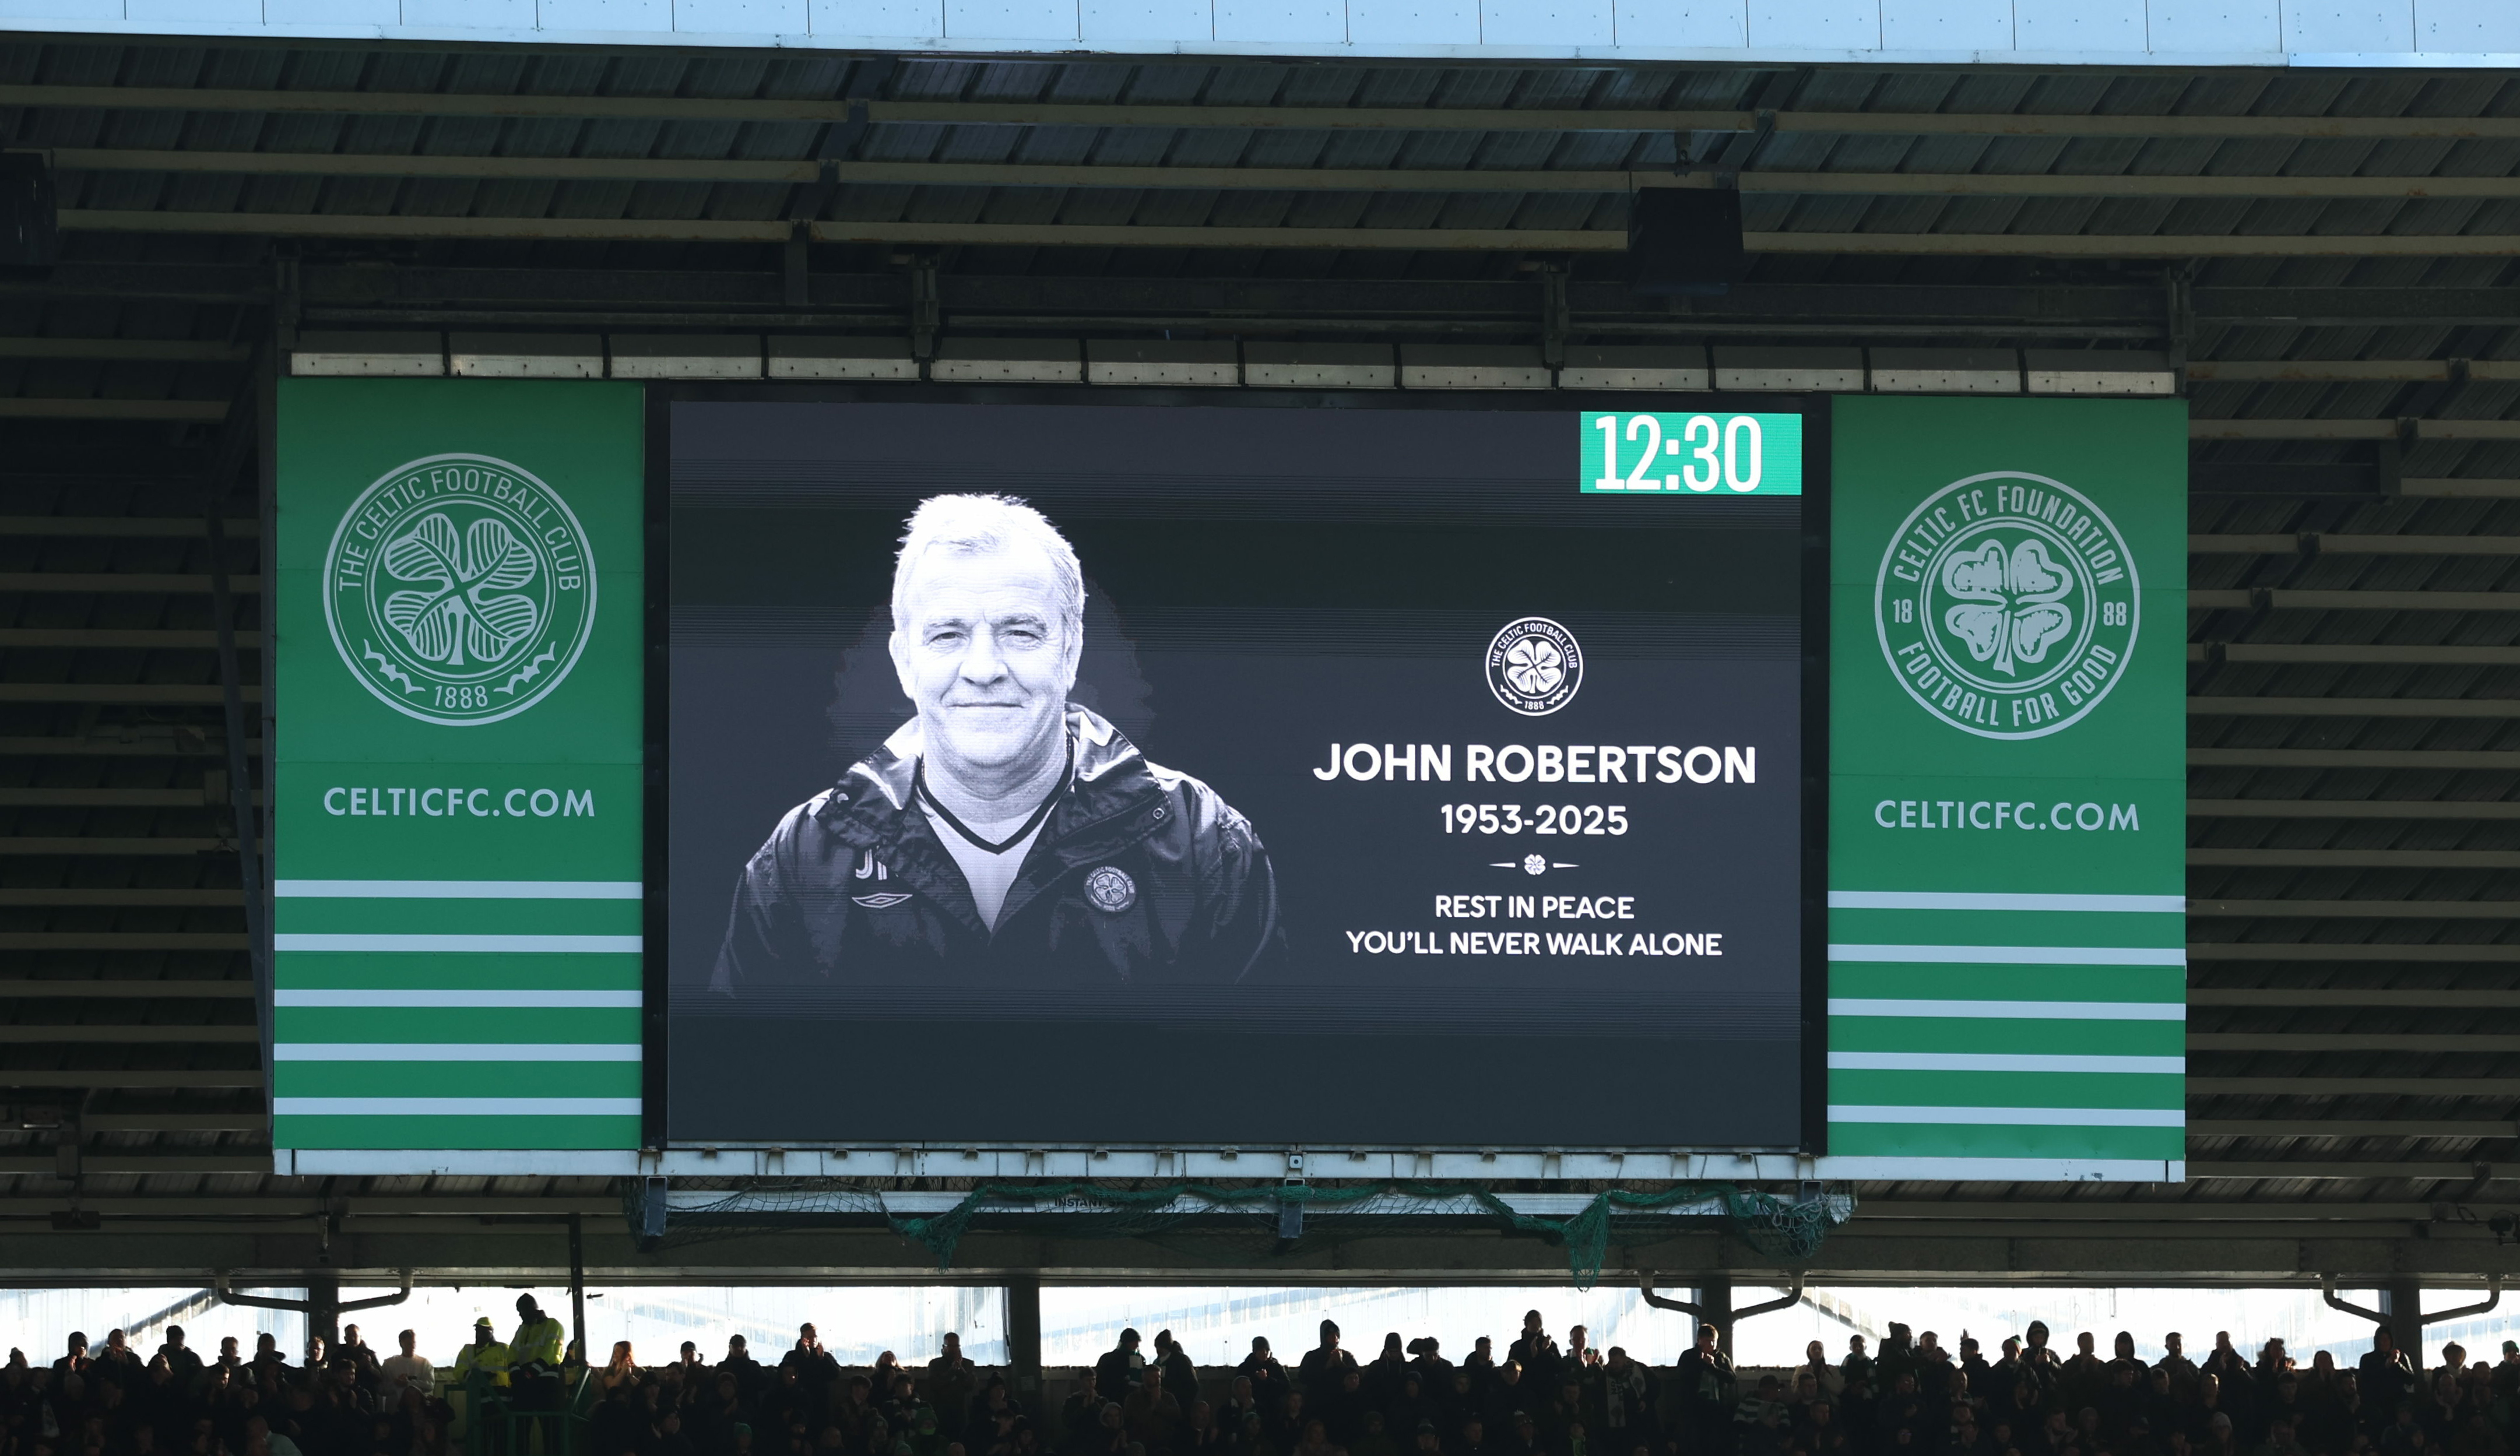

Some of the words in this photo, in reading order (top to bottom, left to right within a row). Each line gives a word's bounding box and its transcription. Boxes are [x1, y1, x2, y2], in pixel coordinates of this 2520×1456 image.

[1595, 415, 1762, 492] 12:30
[340, 543, 368, 591] THE
[365, 477, 425, 539] CELTIC
[431, 469, 549, 529] FOOTBALL
[546, 527, 580, 590] CLUB
[1894, 508, 1955, 582] CELTIC
[1957, 490, 1987, 520] FC
[1998, 486, 2123, 585] FOUNDATION
[1893, 599, 1912, 623] 18
[2104, 602, 2126, 625] 88
[1491, 649, 1503, 667] THE
[1498, 625, 1524, 649] CELTIC
[1524, 623, 1567, 646] FOOTBALL
[1564, 644, 1578, 669] CLUB
[435, 685, 487, 709] 1888
[1898, 642, 1998, 726] FOOTBALL
[2012, 693, 2059, 726] FOR
[2061, 645, 2116, 705] GOOD
[1524, 701, 1545, 710] 1888
[1313, 743, 1451, 782] JOHN
[1467, 744, 1756, 783] ROBERTSON
[324, 787, 595, 817] CELTICFC.COM
[1875, 800, 2139, 831] CELTICFC.COM
[1441, 804, 1628, 836] 1953-2025
[1436, 895, 1502, 918] REST
[1509, 895, 1534, 918] IN
[1542, 896, 1635, 919] PEACE
[1450, 931, 1541, 955] NEVER
[1545, 933, 1623, 956] WALK
[1628, 933, 1723, 956] ALONE
